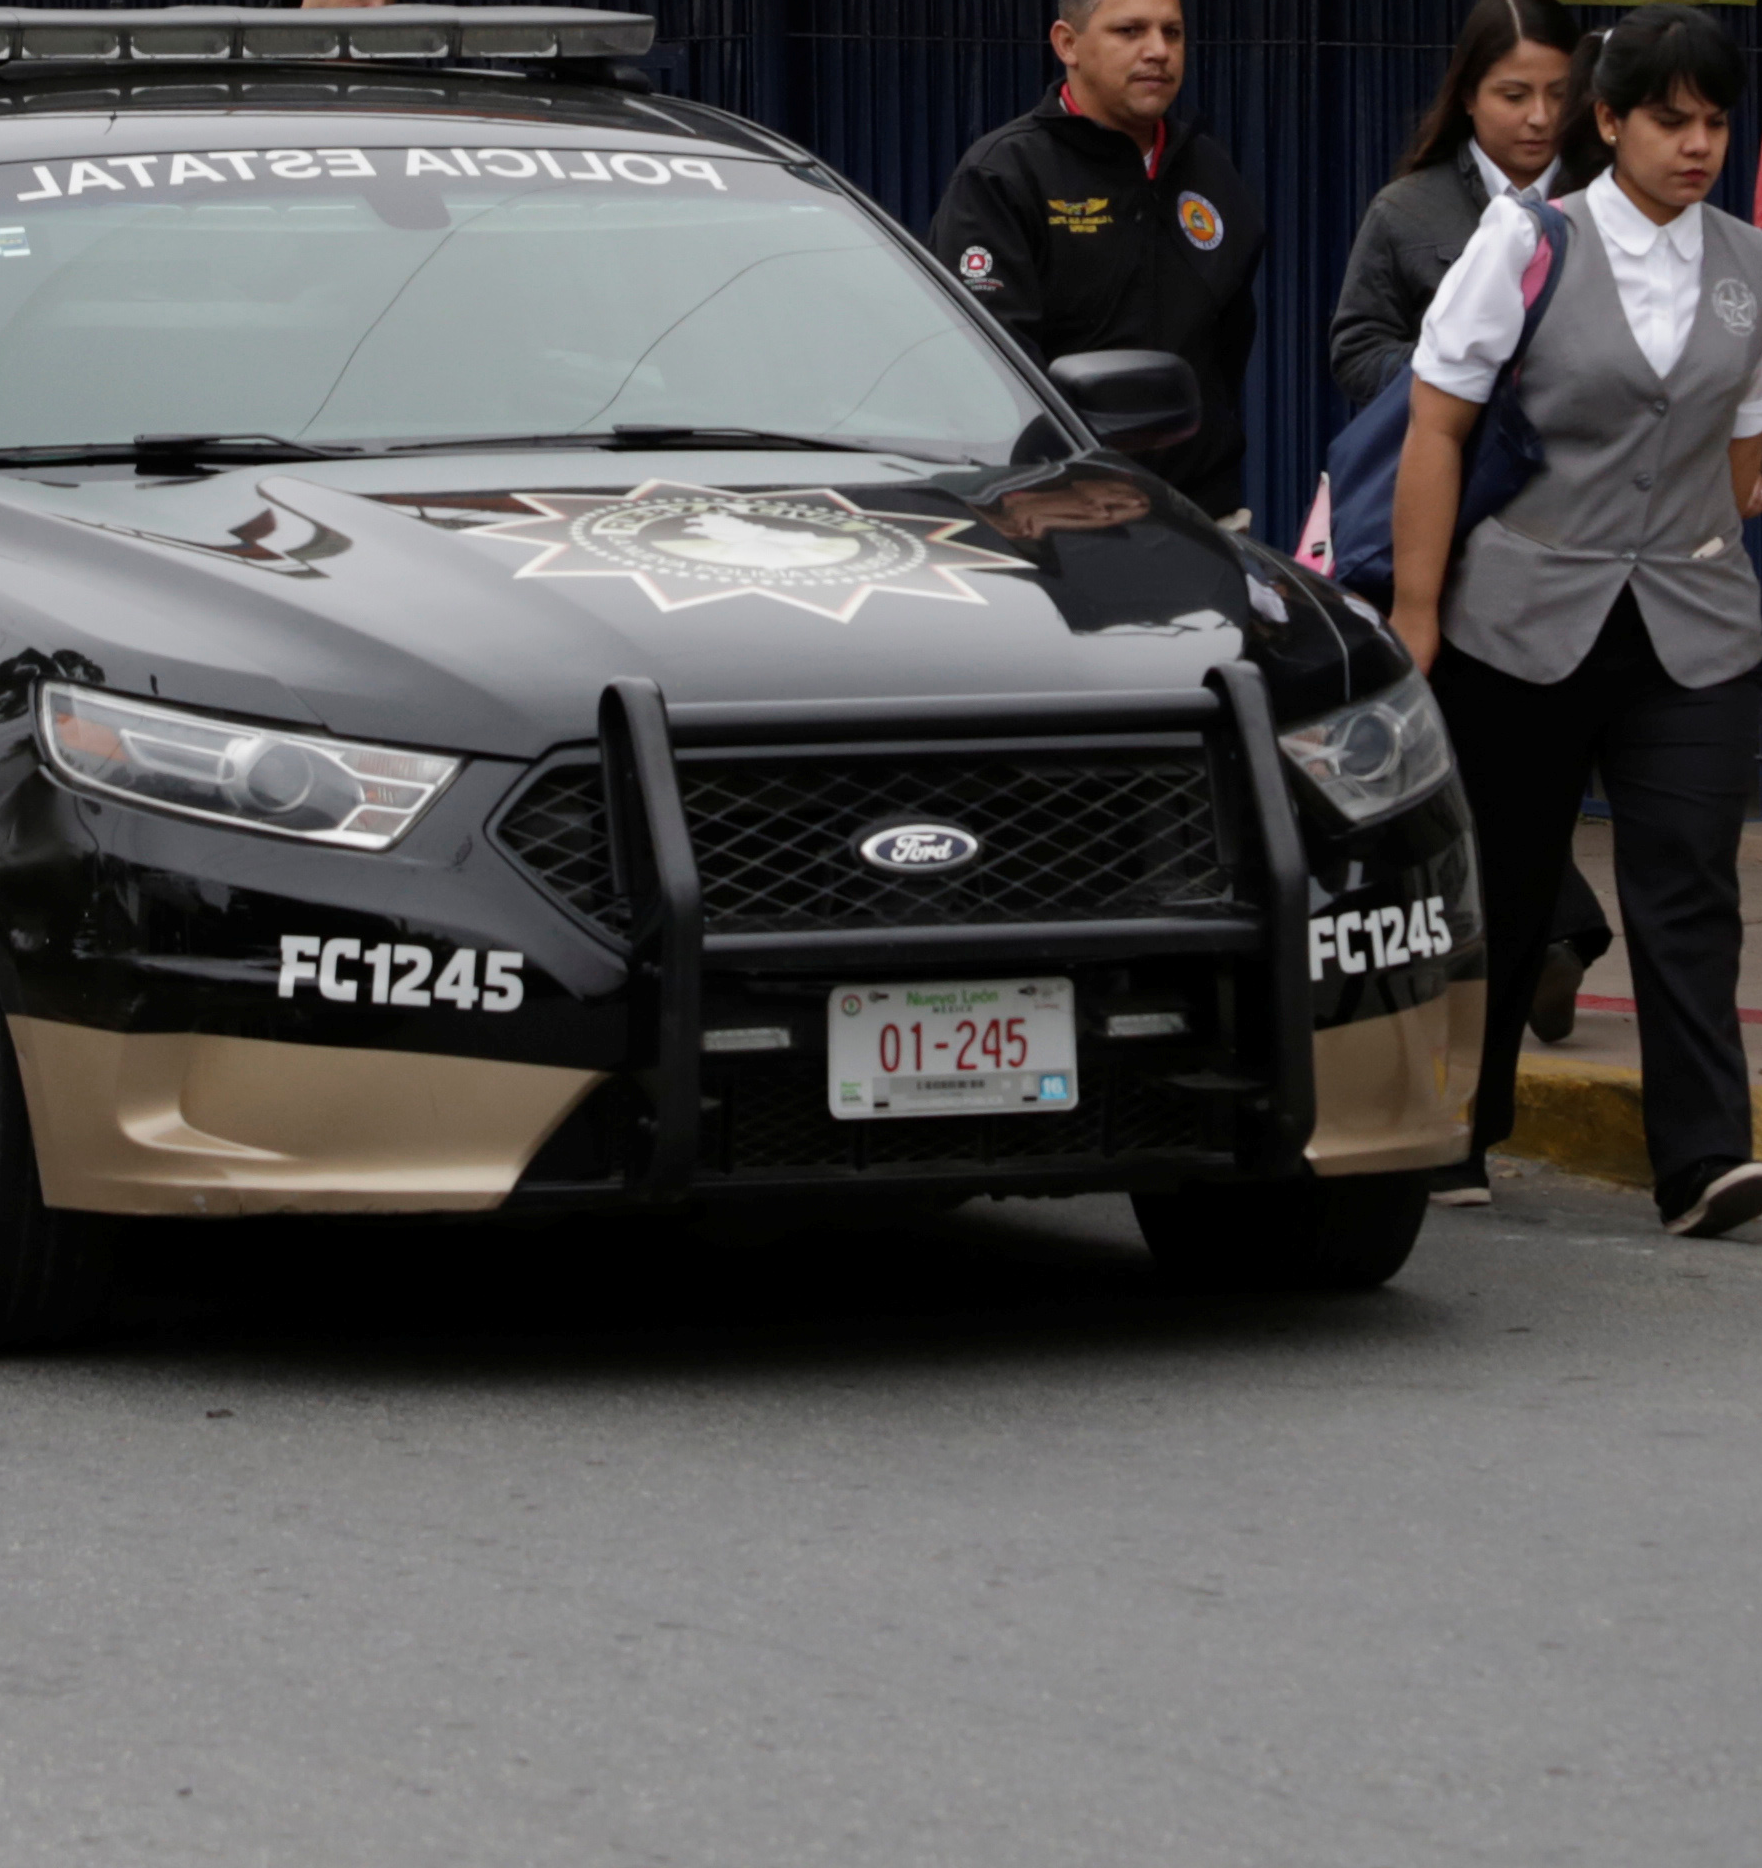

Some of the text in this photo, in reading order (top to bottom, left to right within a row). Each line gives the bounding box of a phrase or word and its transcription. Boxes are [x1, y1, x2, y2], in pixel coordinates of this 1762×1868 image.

[890, 833, 953, 863] Ford
[1308, 895, 1454, 982] FC1245
[278, 934, 525, 1013] FC1245
[879, 1017, 1028, 1073] 01-245
